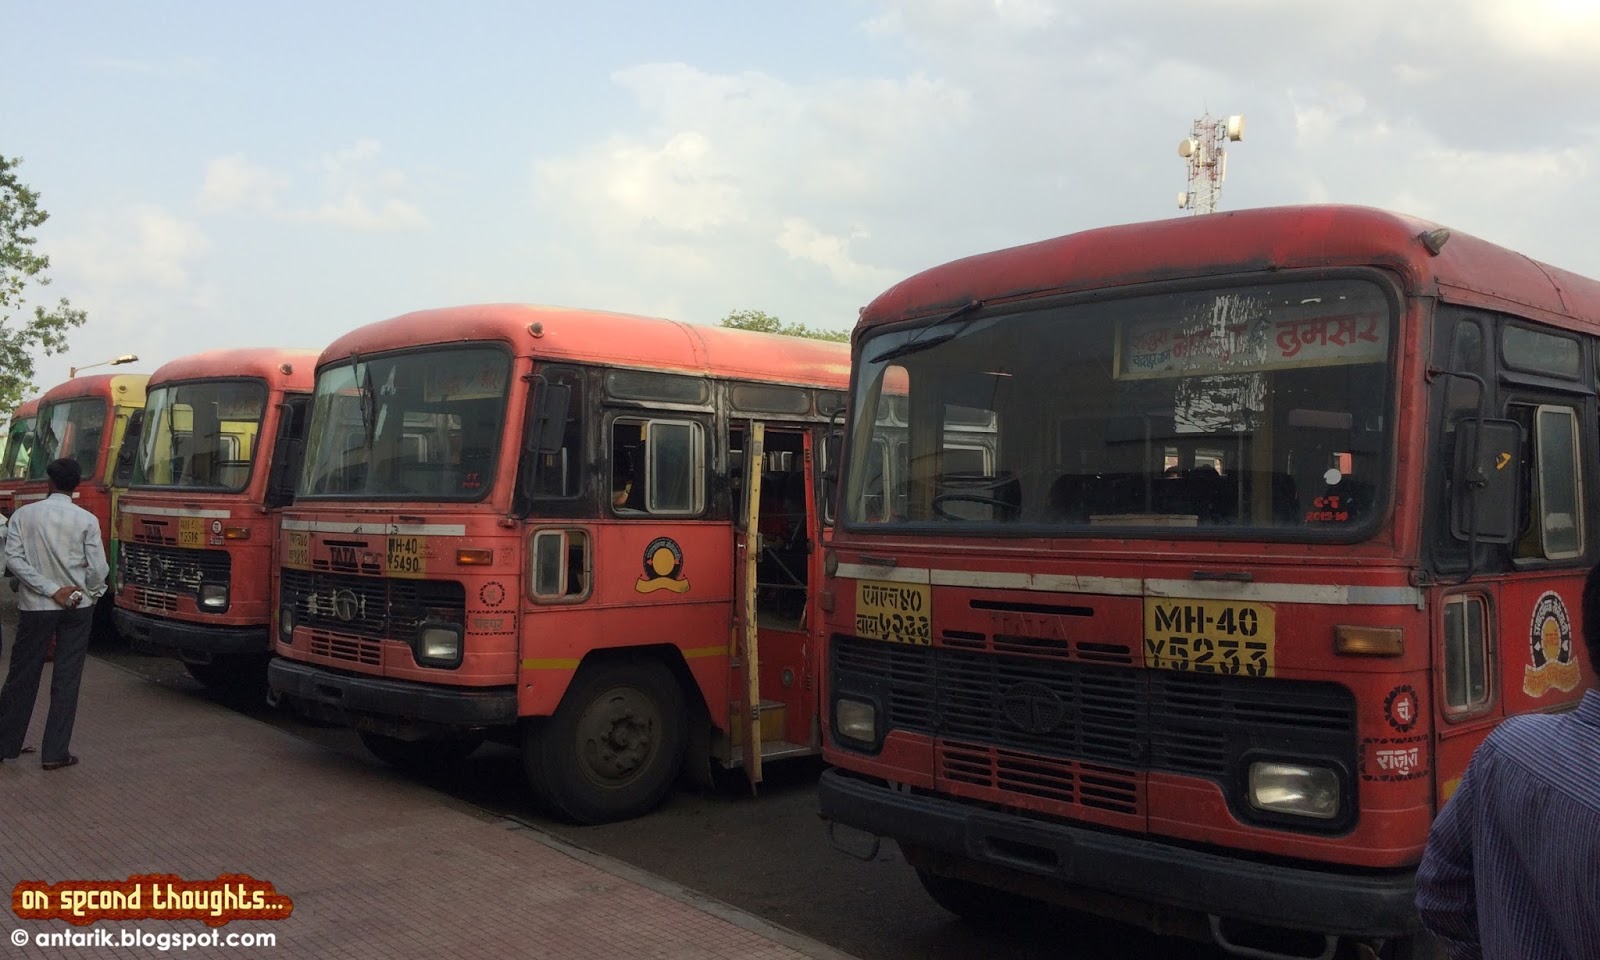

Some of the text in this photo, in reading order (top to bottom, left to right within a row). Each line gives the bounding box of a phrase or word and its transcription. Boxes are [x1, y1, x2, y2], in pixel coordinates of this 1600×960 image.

[1275, 312, 1380, 358] तुमसर
[1154, 605, 1258, 637] MH-40
[1375, 747, 1420, 776] राजुरा
